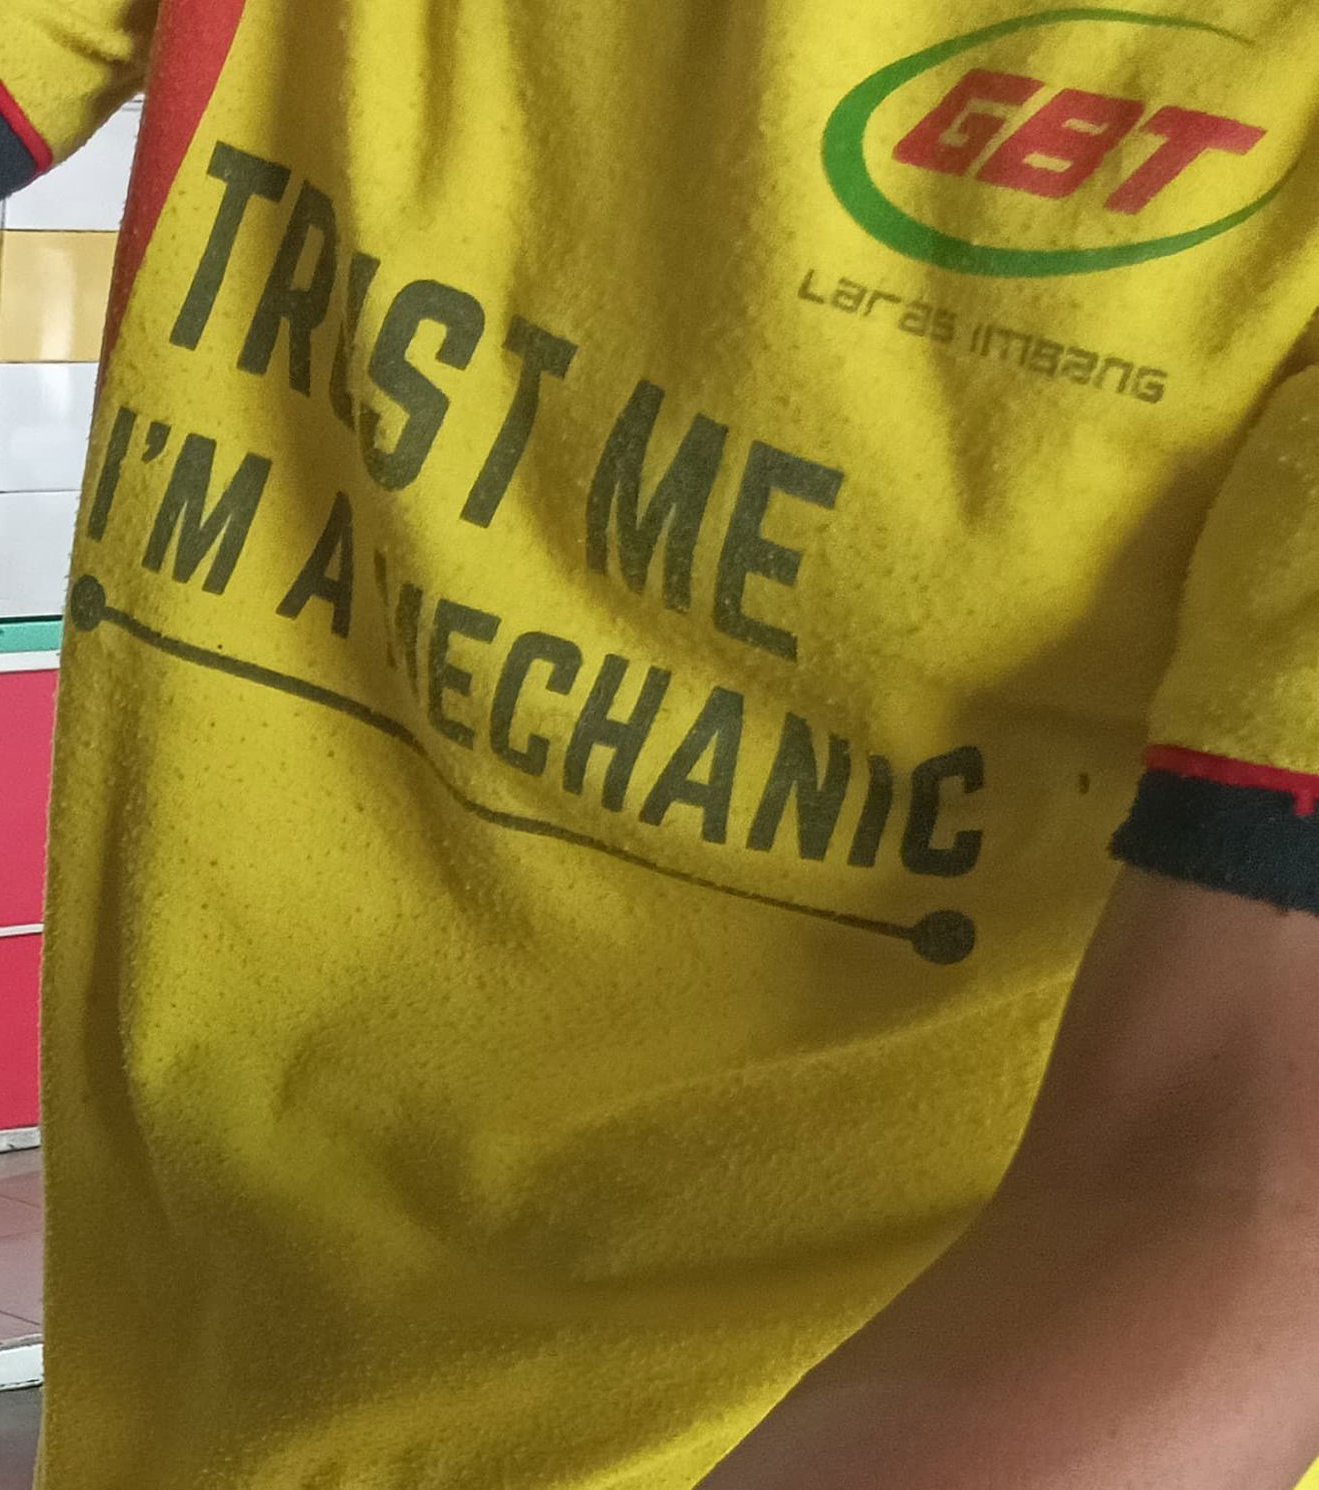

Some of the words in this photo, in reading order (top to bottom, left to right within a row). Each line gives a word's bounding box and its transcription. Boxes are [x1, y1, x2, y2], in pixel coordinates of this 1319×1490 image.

[892, 66, 1268, 216] GBT
[87, 405, 273, 596] I'M
[275, 491, 354, 639] A
[585, 380, 844, 663] ME
